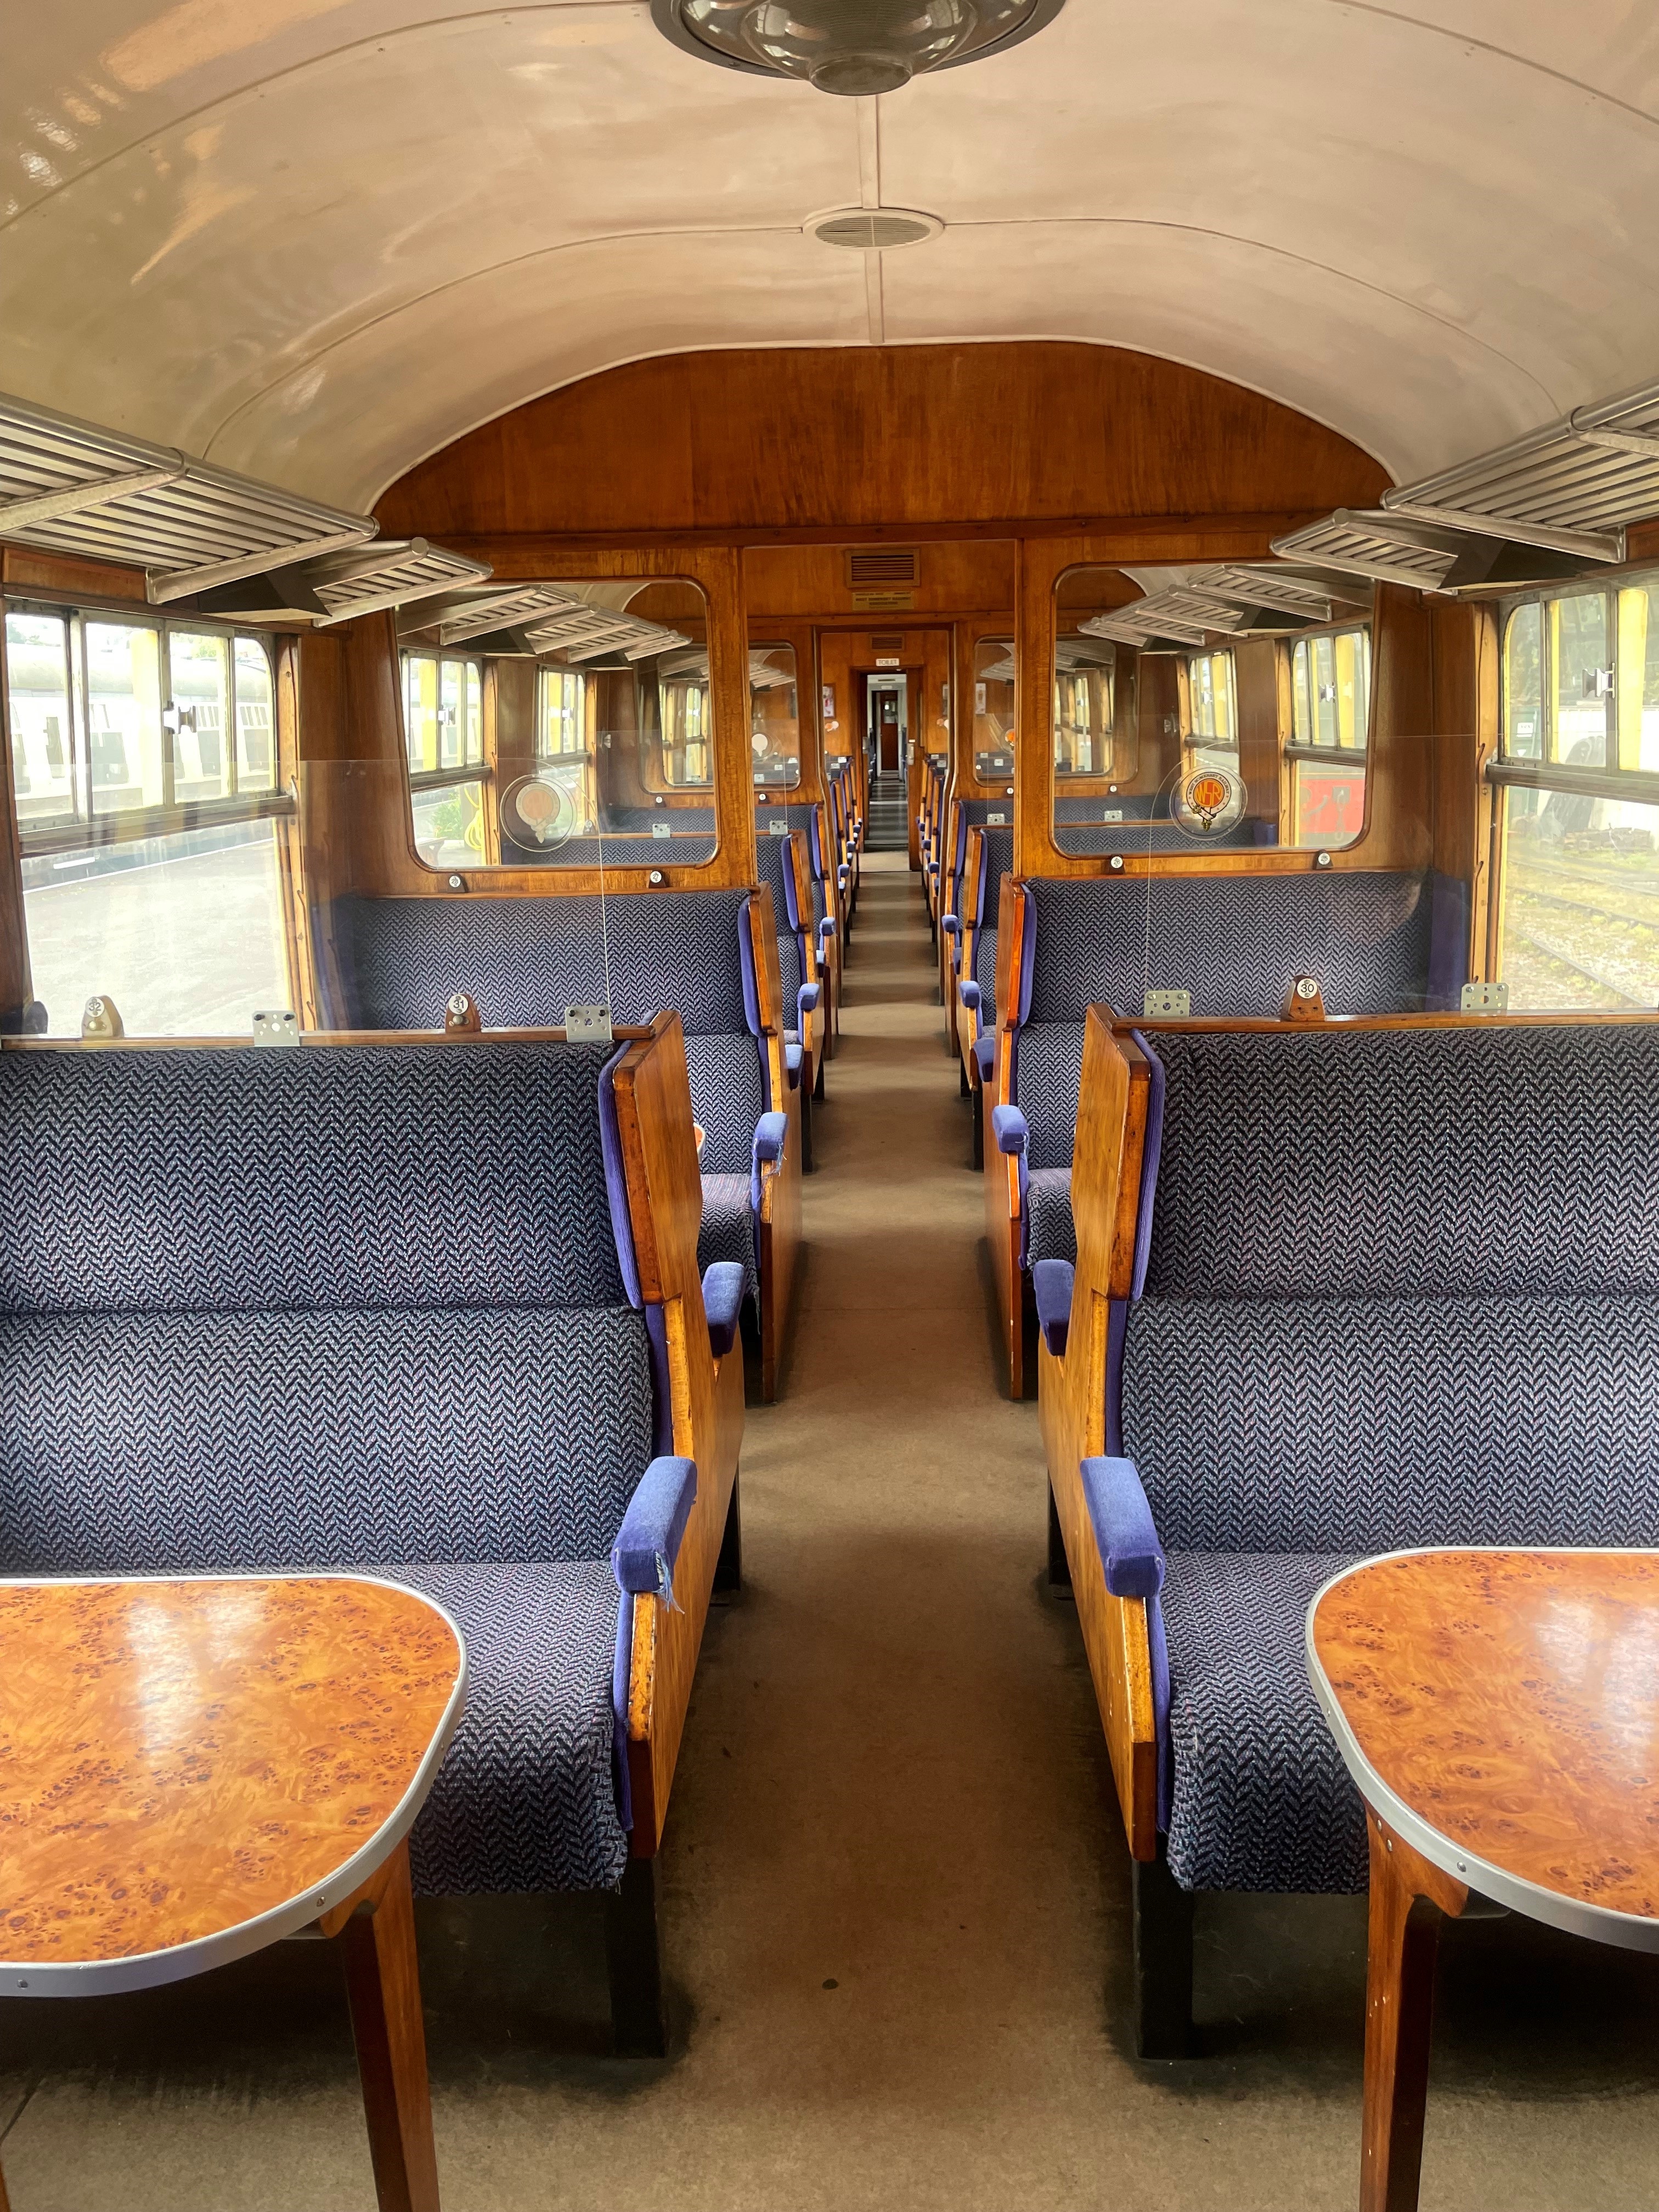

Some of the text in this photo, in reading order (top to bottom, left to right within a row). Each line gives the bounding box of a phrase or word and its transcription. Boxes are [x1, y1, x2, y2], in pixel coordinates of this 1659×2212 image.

[1194, 774, 1218, 783] SOMERSET
[1218, 776, 1229, 794] RAILWAY
[1301, 984, 1314, 993] 30
[89, 1002, 101, 1011] 32
[453, 1000, 464, 1009] 31
